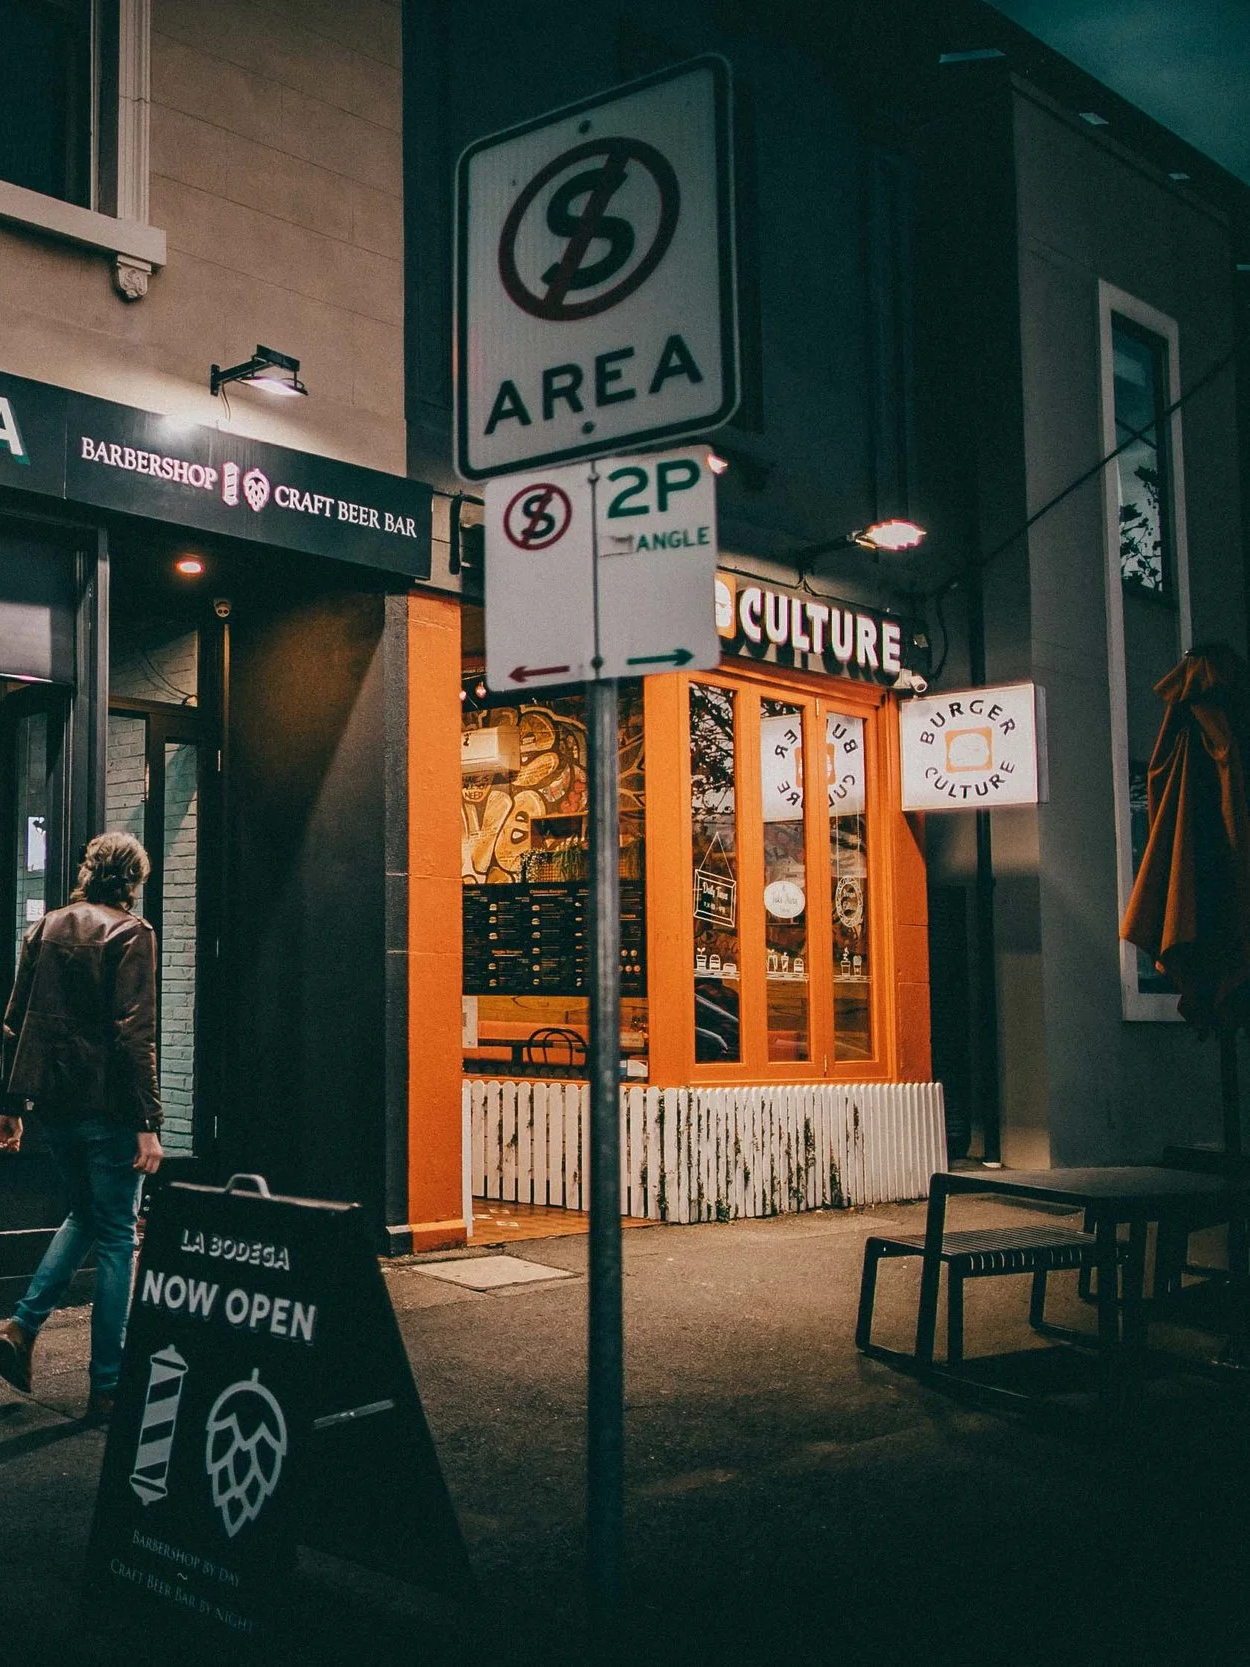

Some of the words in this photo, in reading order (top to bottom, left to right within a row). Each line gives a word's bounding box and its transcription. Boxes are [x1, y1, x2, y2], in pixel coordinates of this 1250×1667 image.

[484, 334, 704, 435] AREA
[81, 437, 218, 491] BARBERSHOP
[607, 459, 700, 519] 2P
[275, 486, 334, 518] CRAFT
[337, 501, 380, 530] BEER
[384, 513, 417, 538] BAR
[636, 526, 710, 552] ANGLE
[739, 587, 901, 673] CULTURE
[919, 699, 1016, 745] BURGER
[925, 760, 1016, 799] CULTURE
[181, 1228, 205, 1255] LA
[209, 1233, 290, 1271] BODEGA
[141, 1269, 220, 1317] NOW
[225, 1288, 317, 1341] OPEN
